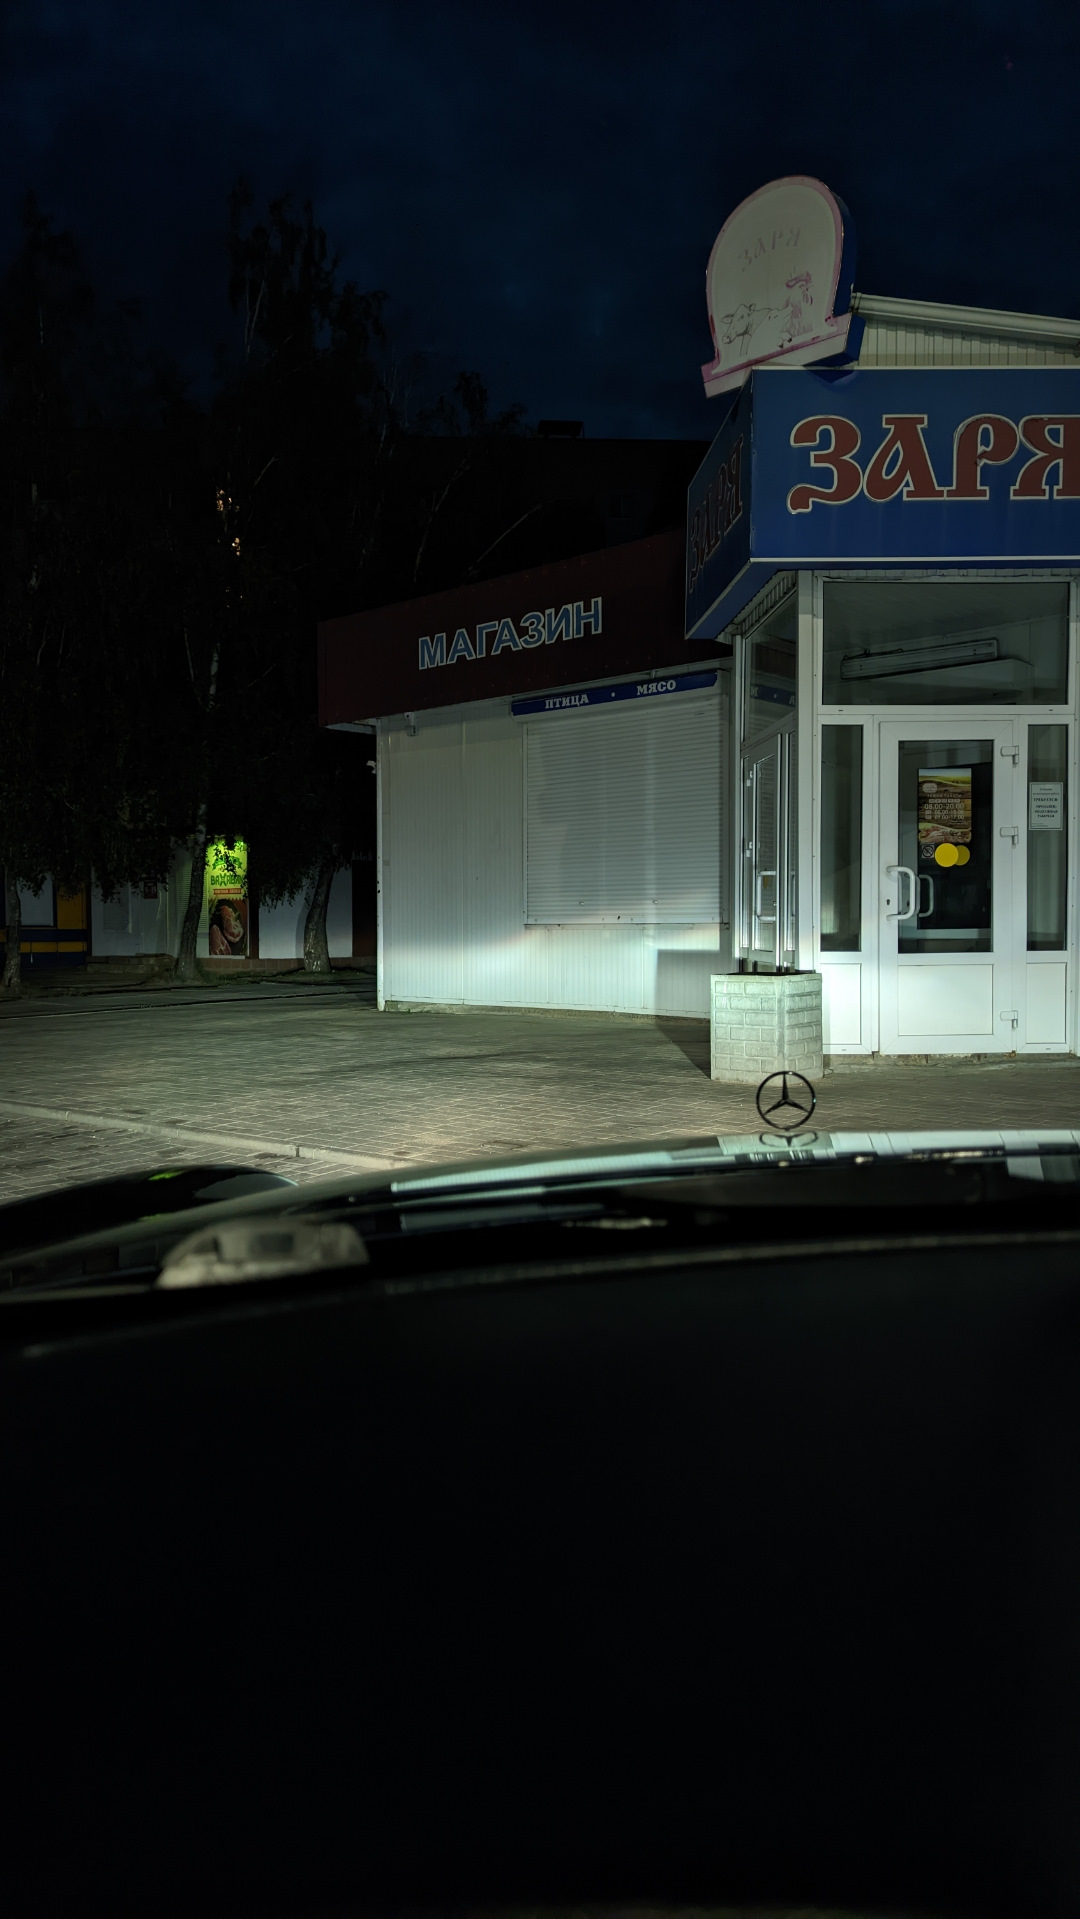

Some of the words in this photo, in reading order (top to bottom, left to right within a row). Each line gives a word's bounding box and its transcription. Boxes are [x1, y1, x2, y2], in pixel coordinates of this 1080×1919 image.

[786, 413, 1080, 515] ЗАРЯ
[689, 433, 744, 594] ЗАРЯ
[418, 596, 602, 670] МАГАЗИН
[544, 694, 590, 709] ПТИЦА
[636, 680, 677, 696] МЯСО
